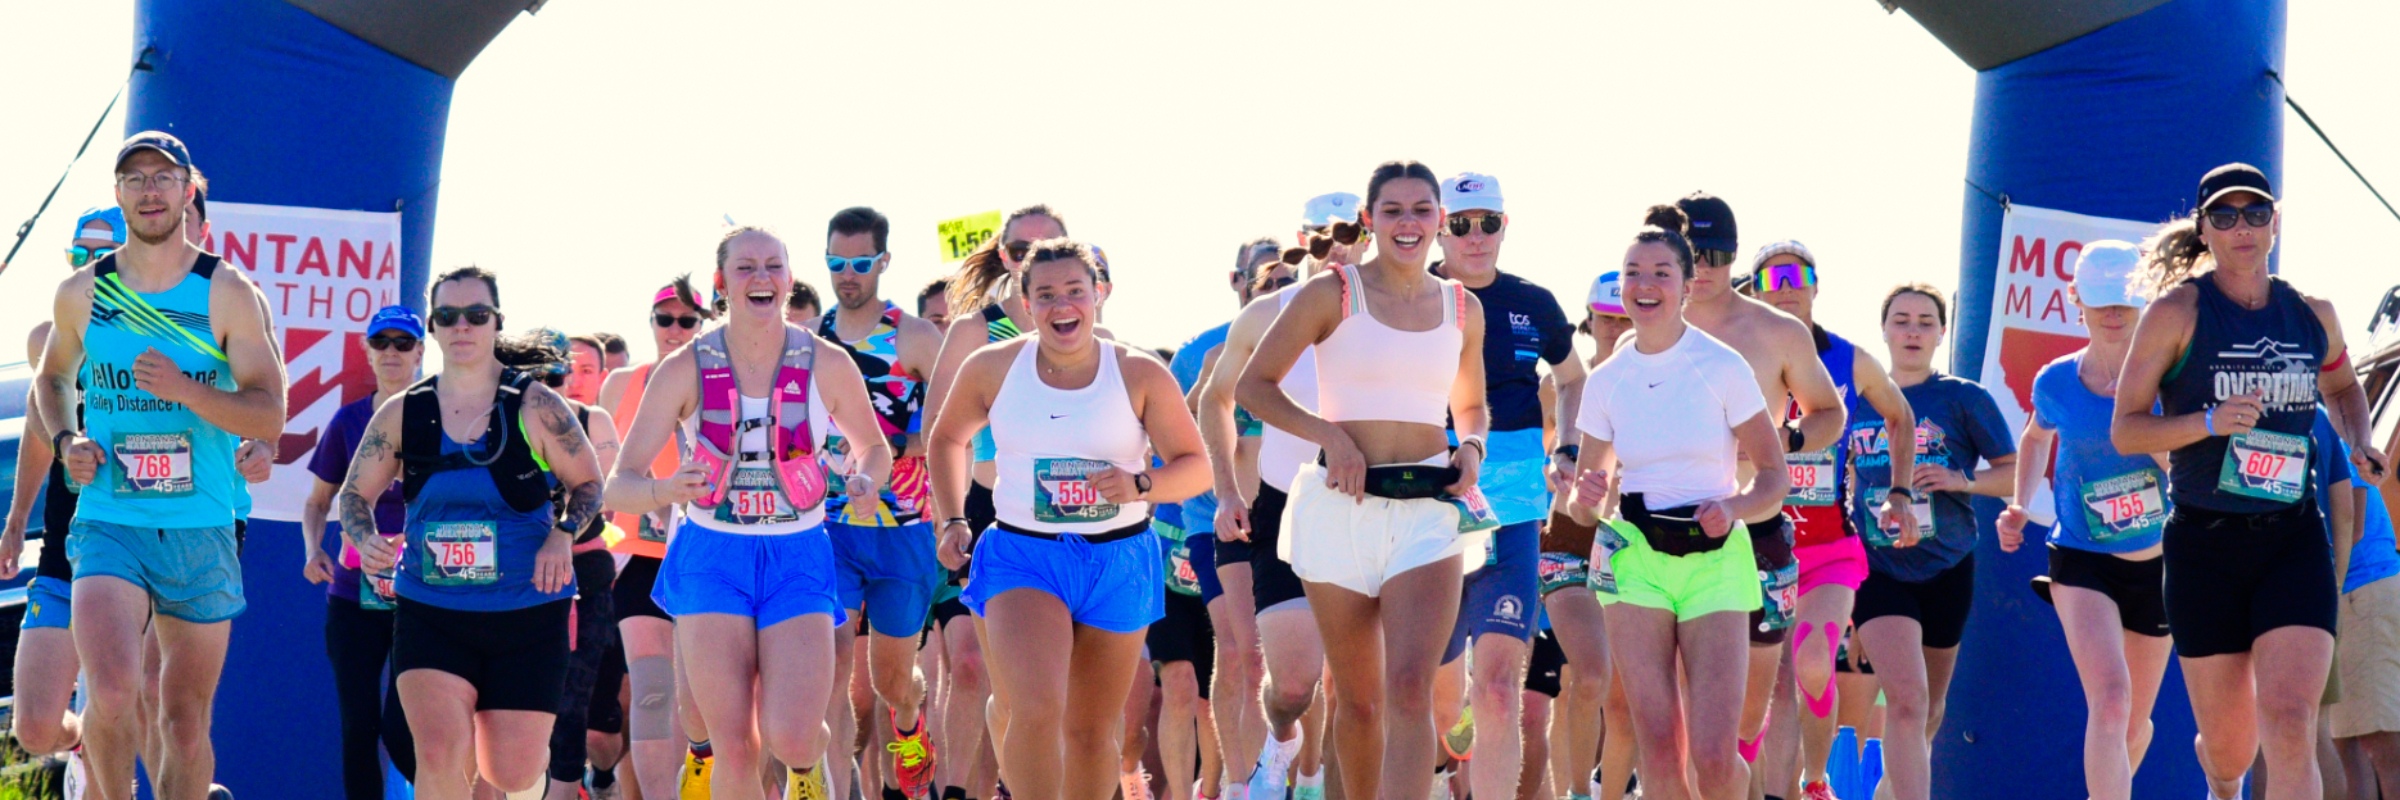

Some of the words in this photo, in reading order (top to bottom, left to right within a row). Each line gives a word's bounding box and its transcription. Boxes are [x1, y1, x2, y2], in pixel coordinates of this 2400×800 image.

[205, 231, 395, 280] NTANA
[2214, 371, 2316, 404] OVERTIME
[117, 394, 172, 411] Distance
[1852, 427, 1928, 454] STAE
[133, 454, 171, 478] 768
[2246, 451, 2286, 478] 607
[153, 480, 173, 492] 45
[1058, 481, 1097, 505] 550
[1799, 489, 1817, 500] 45
[2263, 479, 2283, 494] 45
[738, 491, 775, 515] 510
[1080, 506, 1098, 518] 45
[2106, 494, 2144, 521] 755
[2132, 513, 2150, 529] 45
[441, 543, 475, 566] 756
[460, 568, 476, 579] 45
